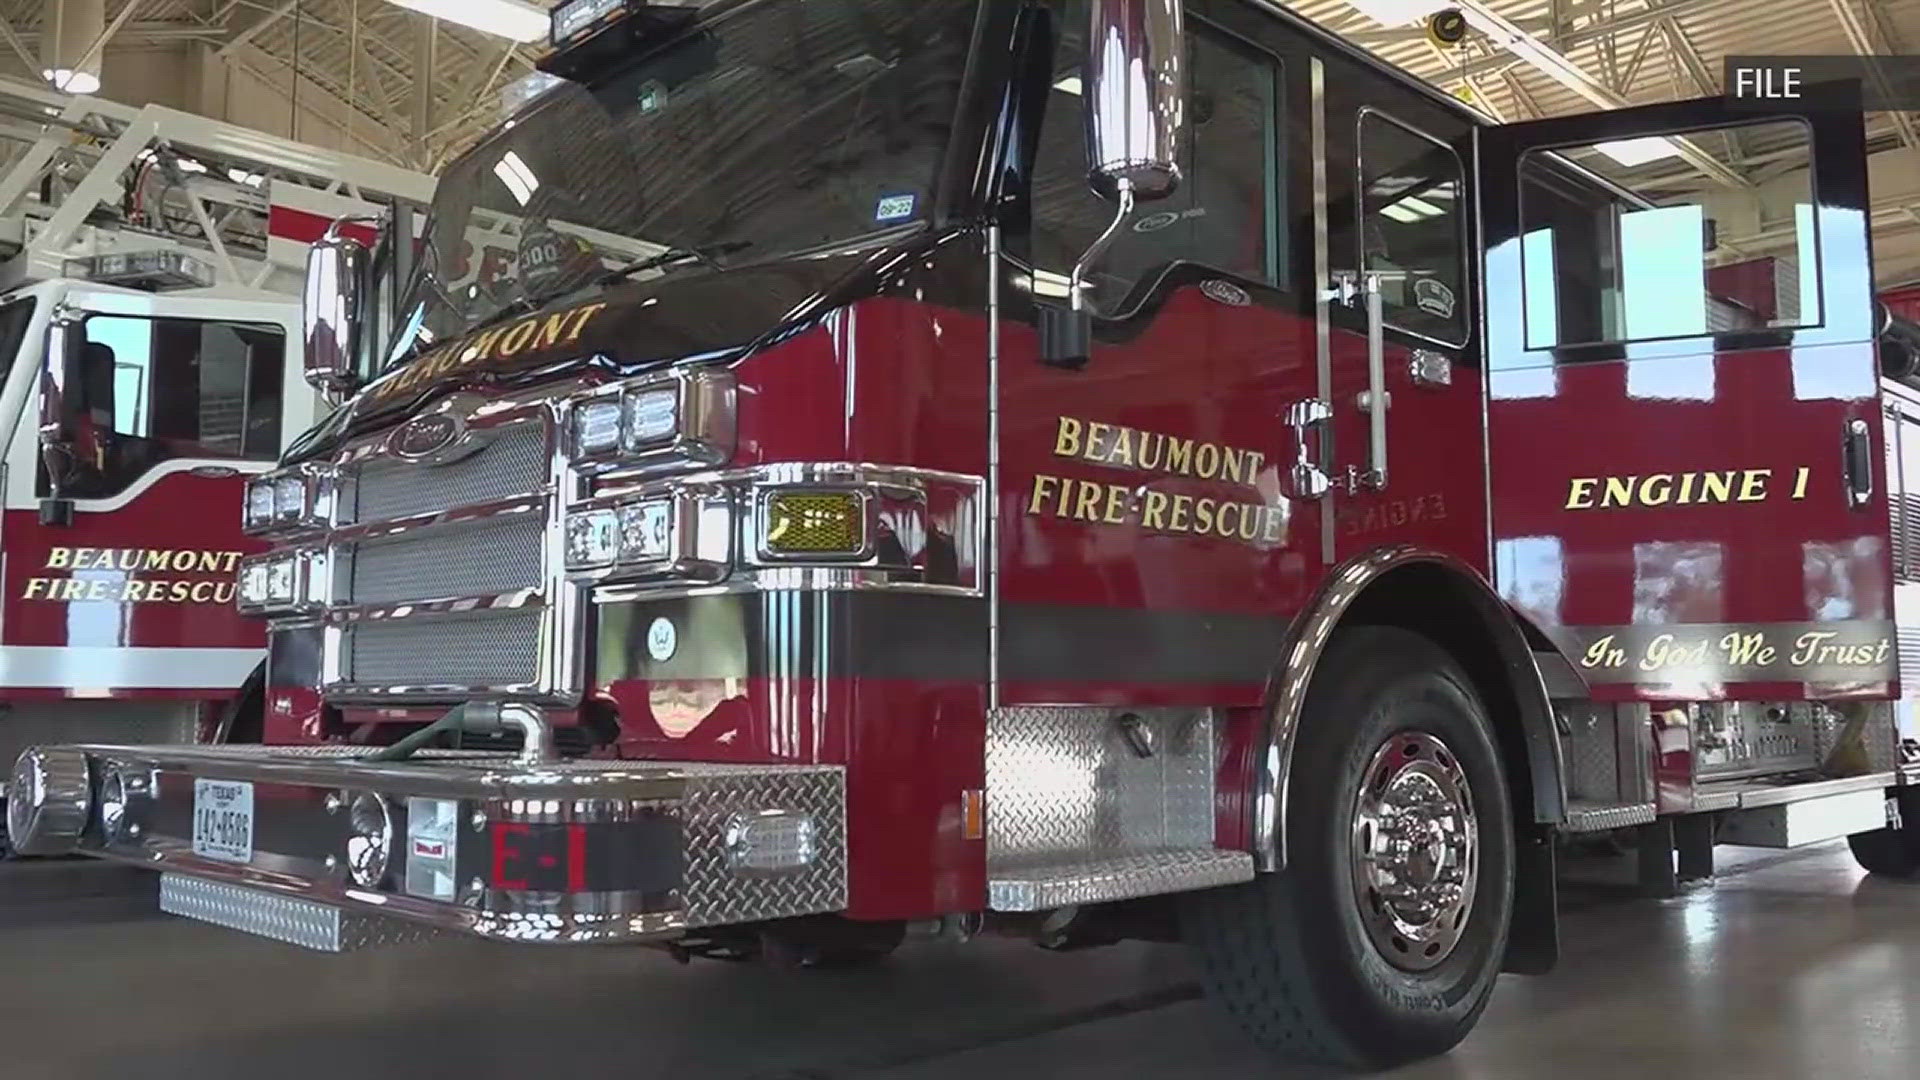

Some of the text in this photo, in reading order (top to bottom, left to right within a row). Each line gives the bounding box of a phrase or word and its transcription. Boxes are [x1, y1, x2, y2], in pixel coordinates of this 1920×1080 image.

[1054, 415, 1265, 485] BEAUMONT
[1564, 468, 1772, 509] ENGINE
[46, 546, 242, 573] BEAUMONT
[22, 577, 237, 604] FIRE-RESCU
[1581, 631, 1889, 671] In God We Trust
